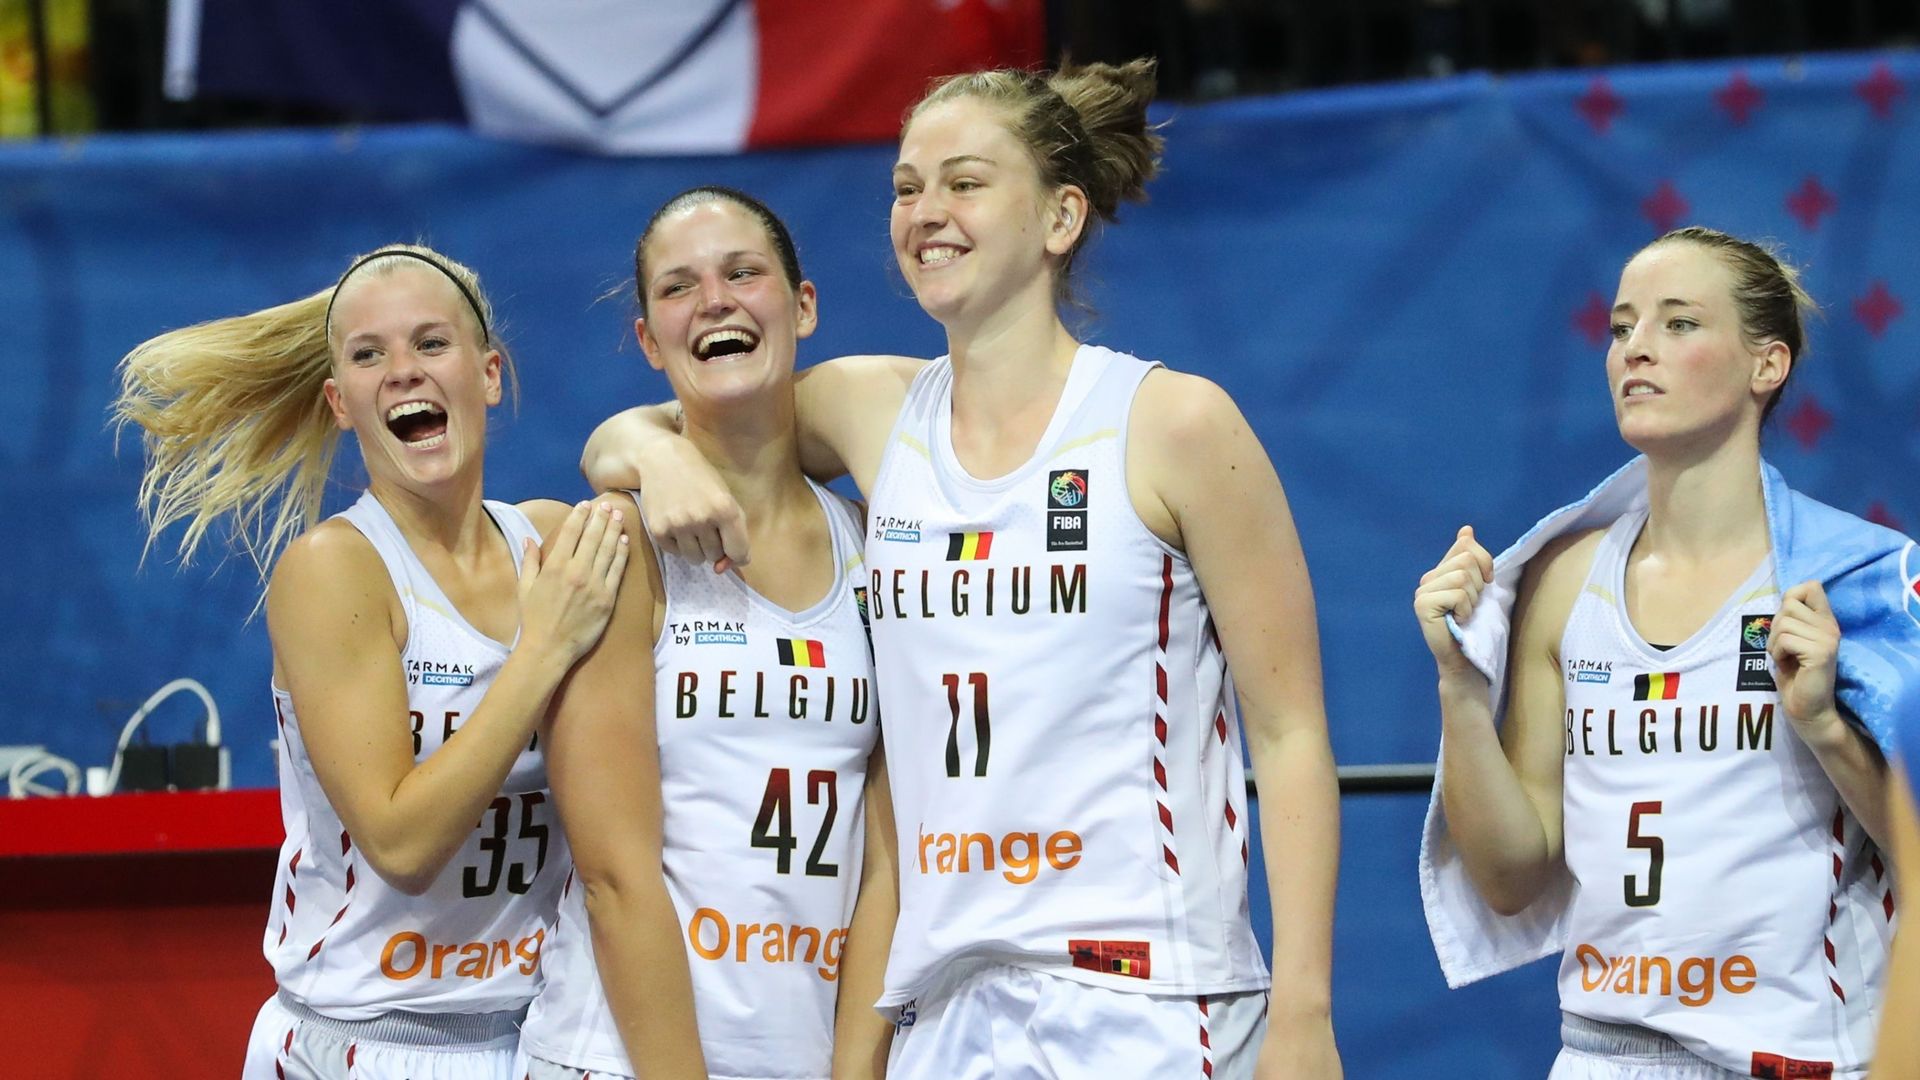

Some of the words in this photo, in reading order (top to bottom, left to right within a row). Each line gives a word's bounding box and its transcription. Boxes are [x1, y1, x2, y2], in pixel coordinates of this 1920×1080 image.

[876, 516, 923, 530] TARMAK
[1053, 515, 1082, 530] FIBA
[872, 564, 1087, 620] BELGIUM
[669, 621, 745, 635] TARMAK
[675, 635, 690, 646] by
[407, 659, 474, 674] TARMAK
[1568, 659, 1612, 671] TARMAK
[675, 670, 872, 727] BELGIU
[942, 672, 991, 778] 11
[1566, 703, 1774, 756] BELGIUM
[462, 791, 549, 899] 35
[751, 767, 839, 877] 42
[915, 823, 1083, 885] range
[1623, 800, 1665, 908] 5
[380, 928, 545, 981] Orang
[688, 907, 850, 982] Orang
[1575, 943, 1758, 1008] Orange
